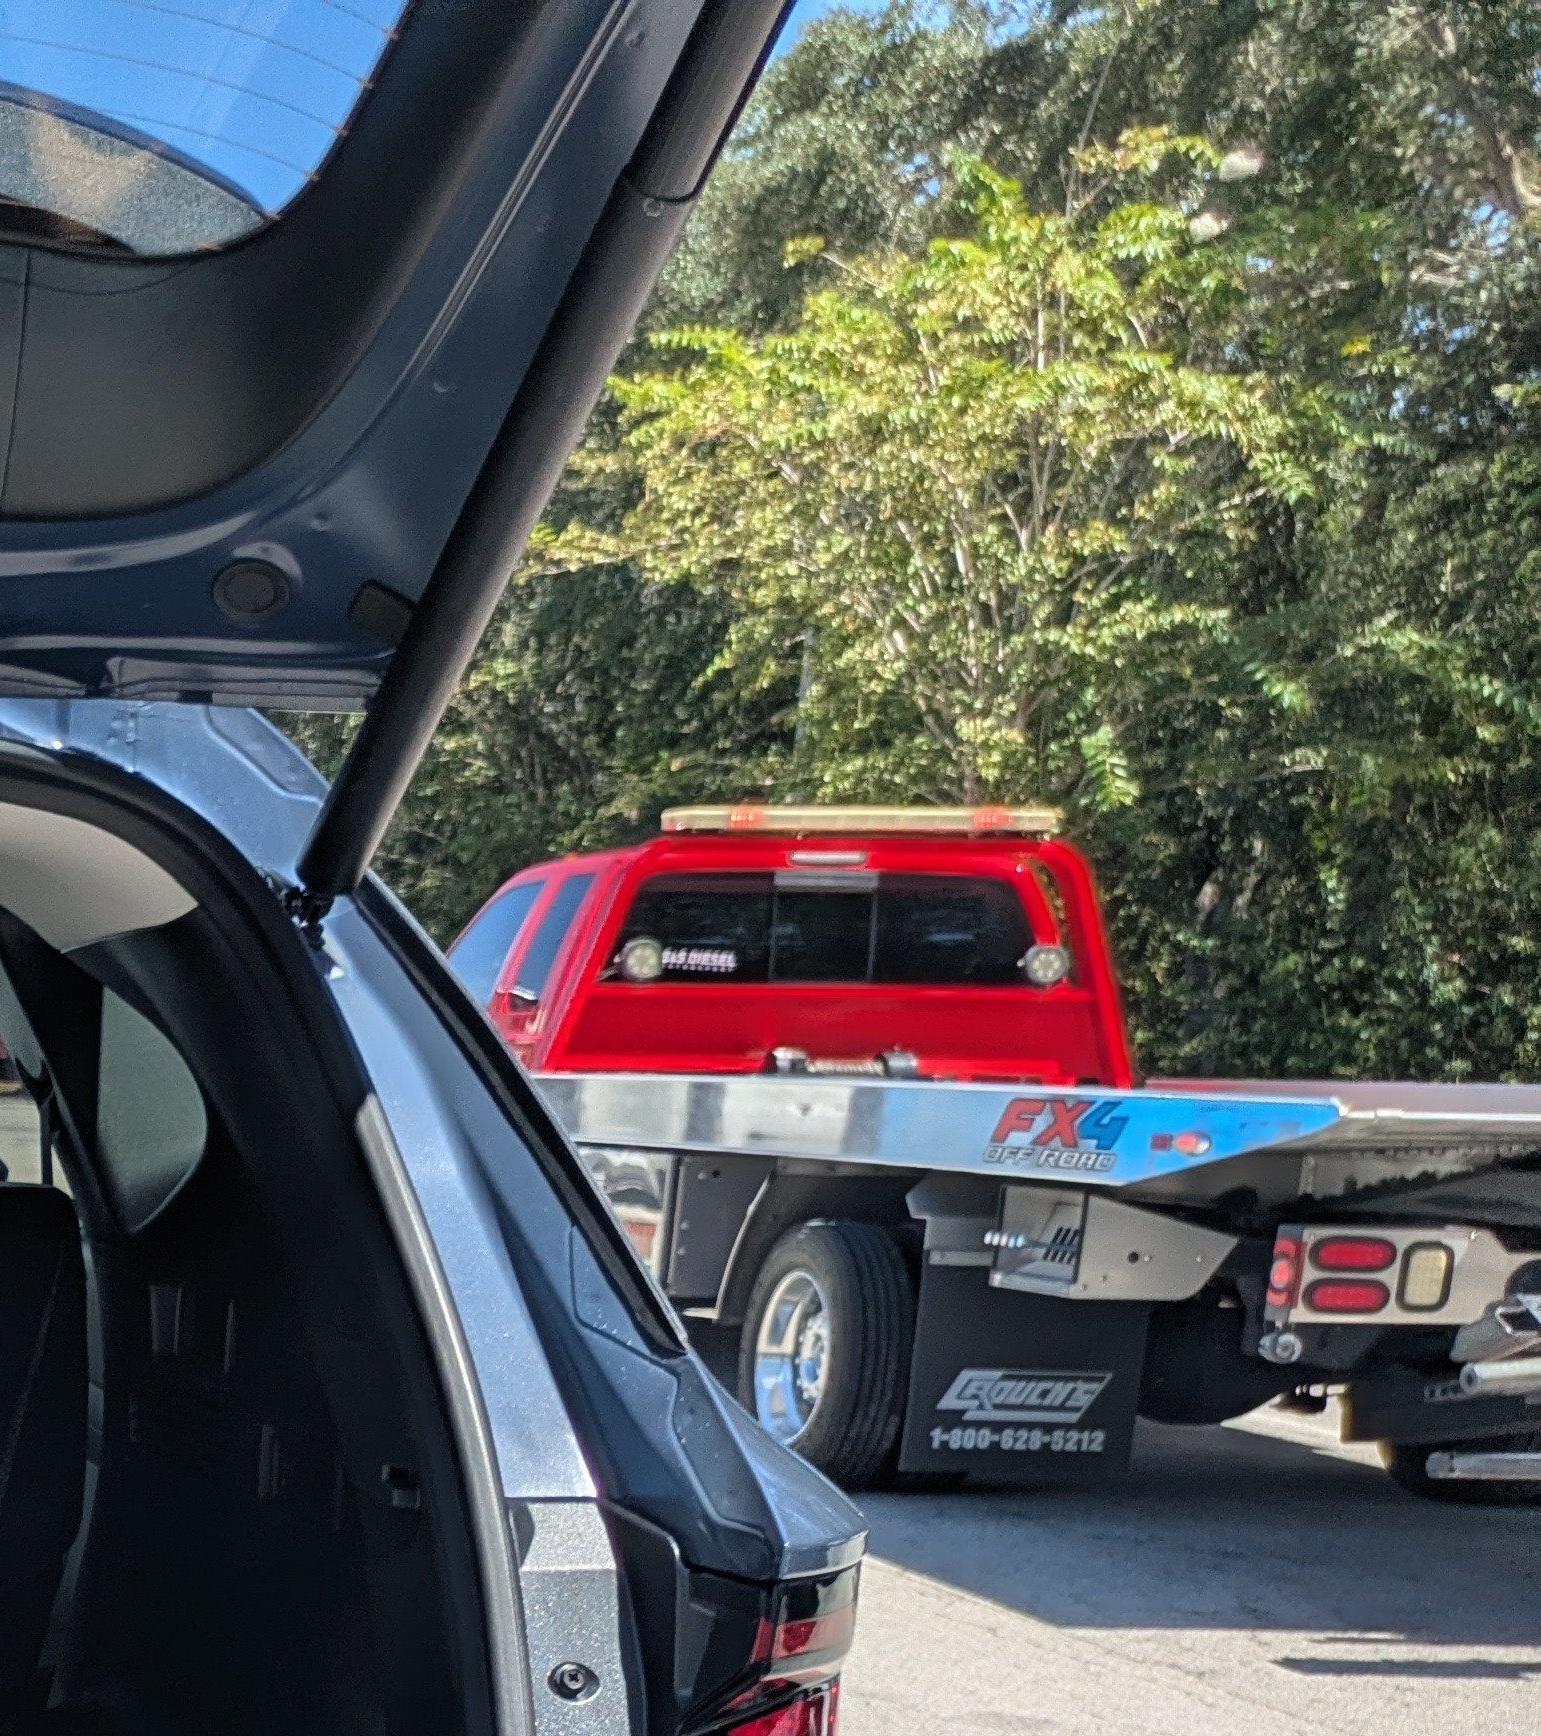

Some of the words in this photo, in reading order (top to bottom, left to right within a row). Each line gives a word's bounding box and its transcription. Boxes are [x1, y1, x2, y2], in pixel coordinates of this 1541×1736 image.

[990, 1097, 1130, 1151] FX4
[982, 1145, 1035, 1166] OFF
[1036, 1149, 1119, 1172] ROAD
